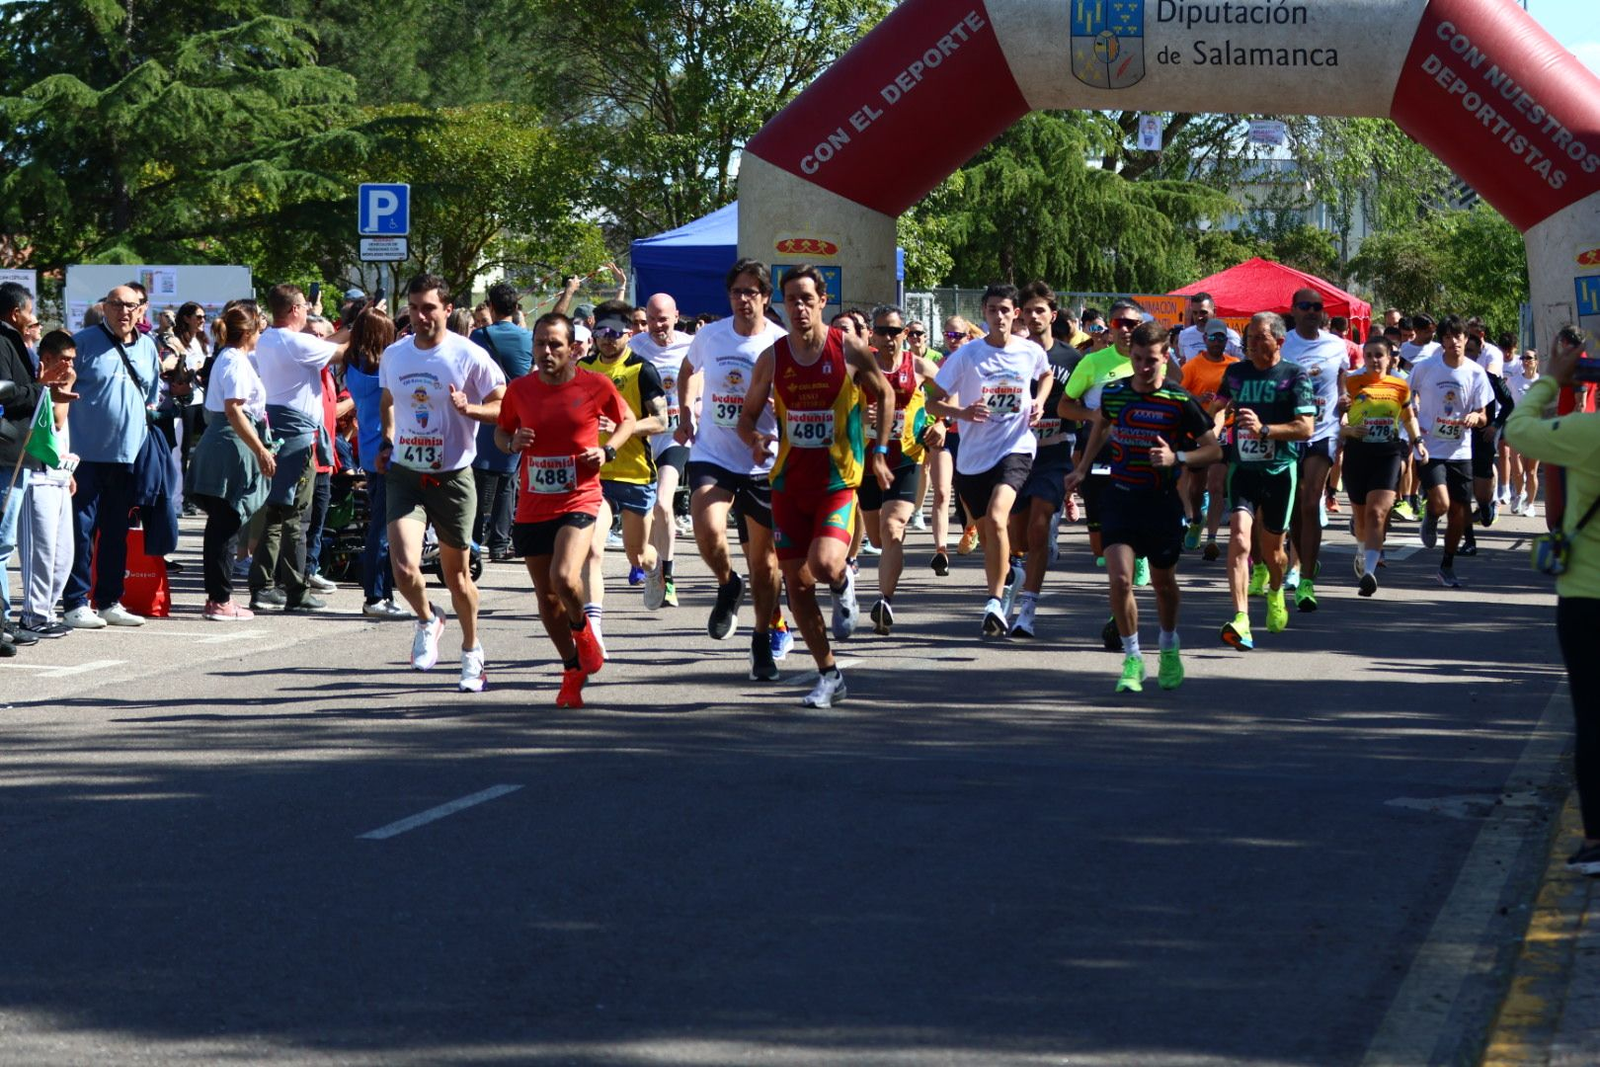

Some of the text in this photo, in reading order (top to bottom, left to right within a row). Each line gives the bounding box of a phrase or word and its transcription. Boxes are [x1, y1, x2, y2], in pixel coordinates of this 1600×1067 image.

[1157, 0, 1307, 29] Diputación
[1157, 40, 1339, 66] de Salamanca
[800, 10, 985, 175] CON EL DEPORTE
[1436, 21, 1600, 173] CON NUESTROS
[1421, 54, 1567, 189] DEPORTISTAS
[369, 190, 398, 231] P
[712, 393, 744, 404] bedun
[987, 394, 1016, 408] 472
[788, 412, 833, 422] bedunia
[794, 423, 826, 439] 480
[1369, 426, 1390, 436] 478
[1438, 425, 1460, 435] 435
[399, 435, 443, 446] bedunia
[1241, 440, 1269, 453] 425
[404, 446, 436, 462] 413
[535, 469, 567, 485] 488
